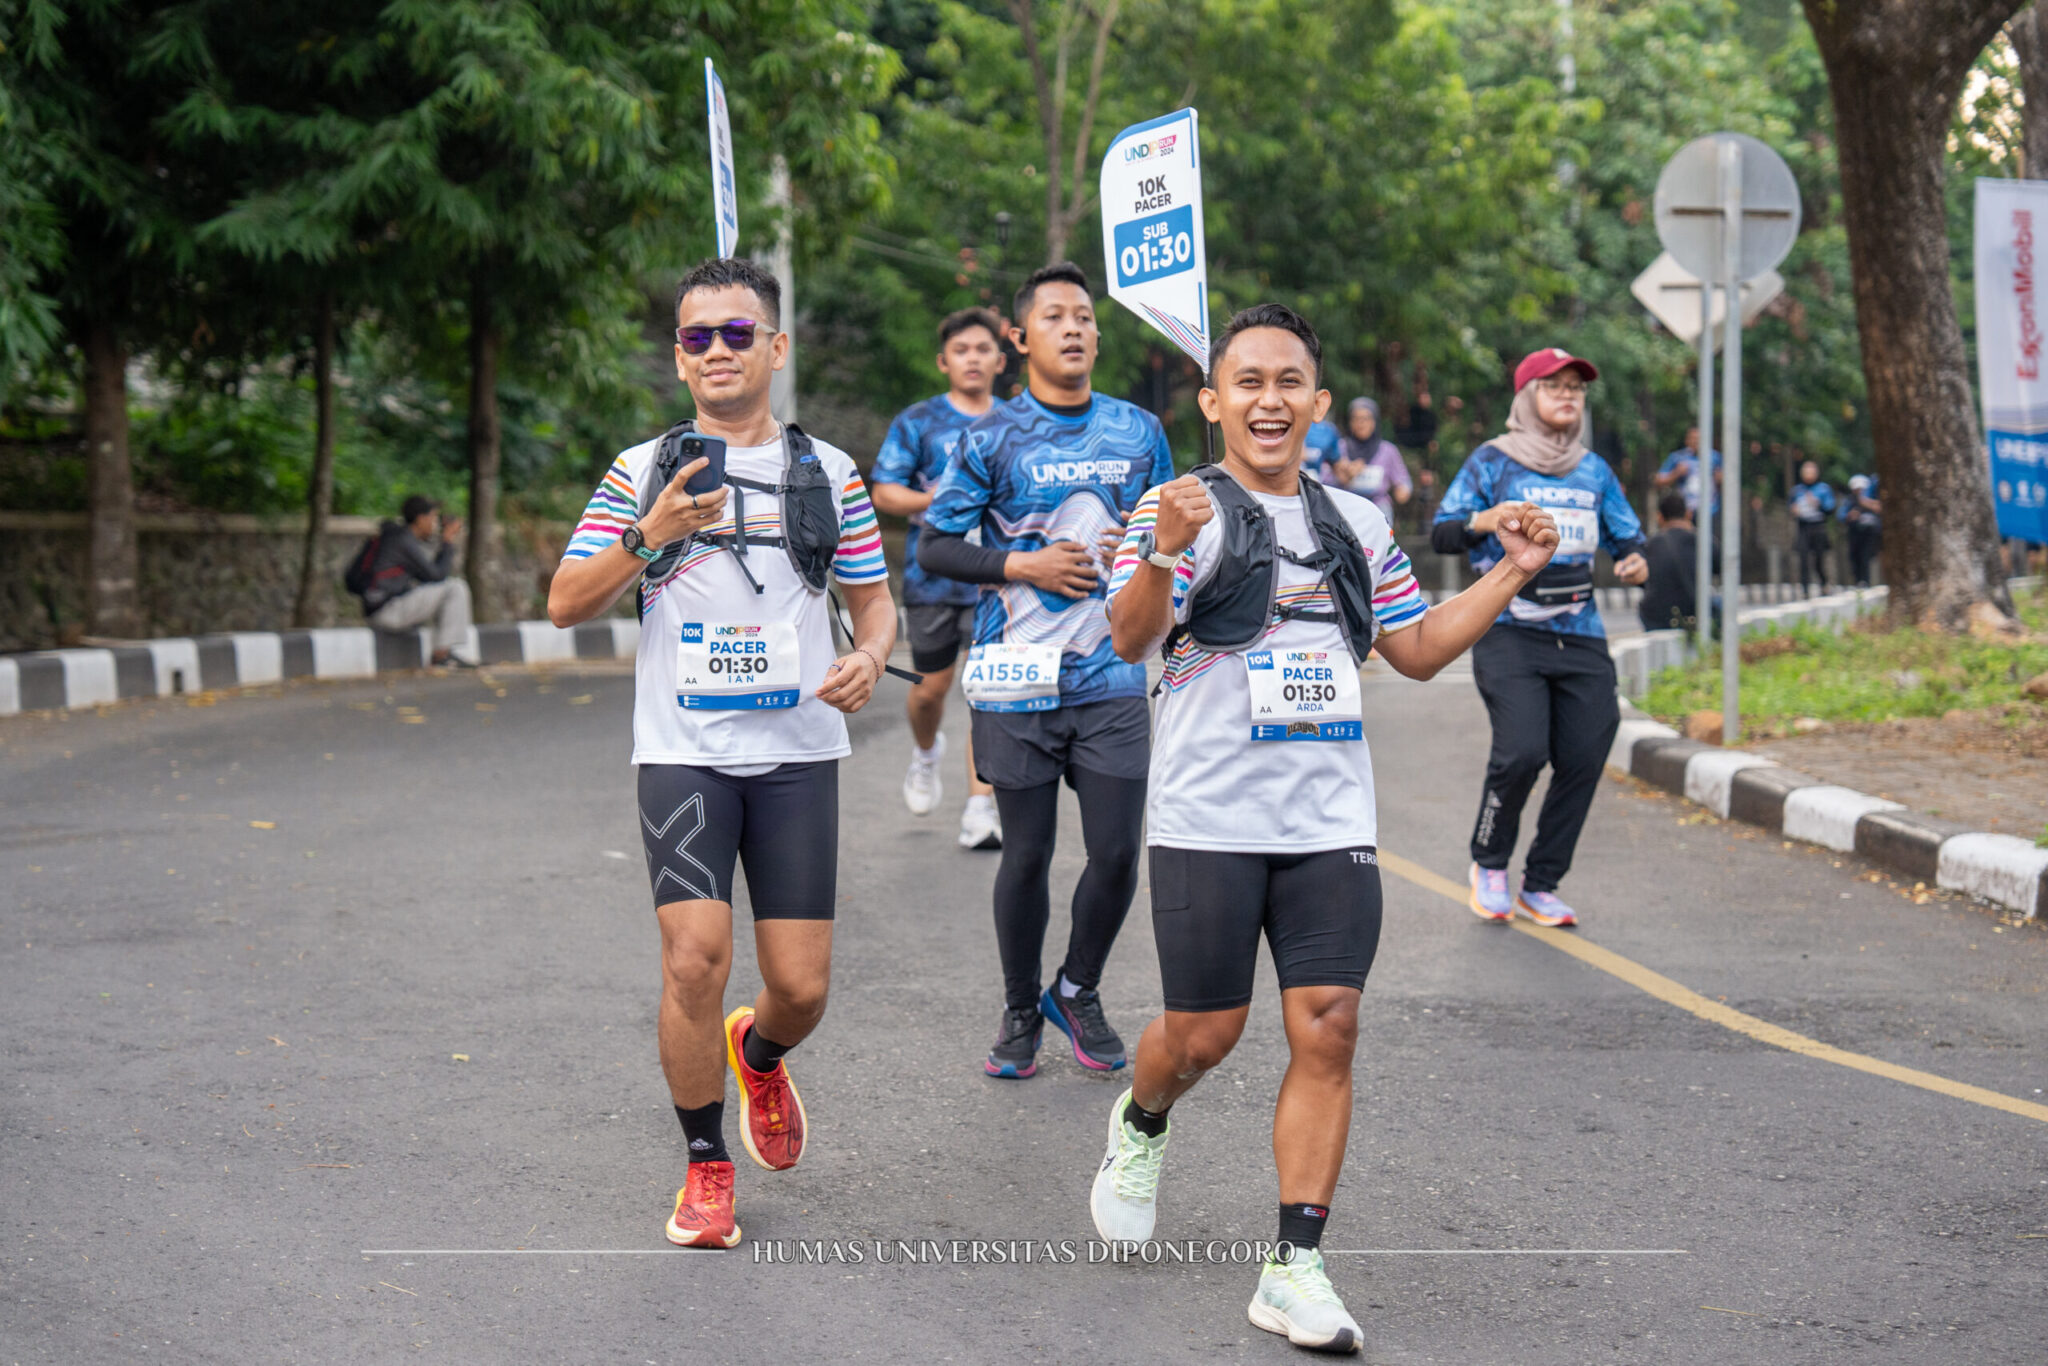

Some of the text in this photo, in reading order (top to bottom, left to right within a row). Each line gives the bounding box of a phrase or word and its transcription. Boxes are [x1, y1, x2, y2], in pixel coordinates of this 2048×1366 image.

[1124, 140, 1158, 161] UNDIP
[1159, 136, 1174, 149] RUN
[1138, 174, 1167, 197] 10K
[1135, 193, 1172, 213] PACER
[1142, 221, 1169, 241] SUB
[1120, 231, 1191, 277] 01:30
[1032, 461, 1125, 483] UNDIP RUN
[1099, 474, 1127, 485] 2024
[683, 627, 702, 637] 10K
[715, 626, 744, 635] UNDIP
[709, 641, 767, 654] PACER
[708, 657, 769, 674] 01:30
[1249, 655, 1272, 665] 10K
[728, 675, 754, 683] IAN
[969, 664, 1040, 682] A1556
[1283, 667, 1333, 680] PACER
[684, 677, 698, 685] AA
[1282, 684, 1336, 702] 01:30
[1259, 706, 1272, 714] AA
[1296, 703, 1325, 712] ARDA
[1350, 851, 1377, 865] TERR
